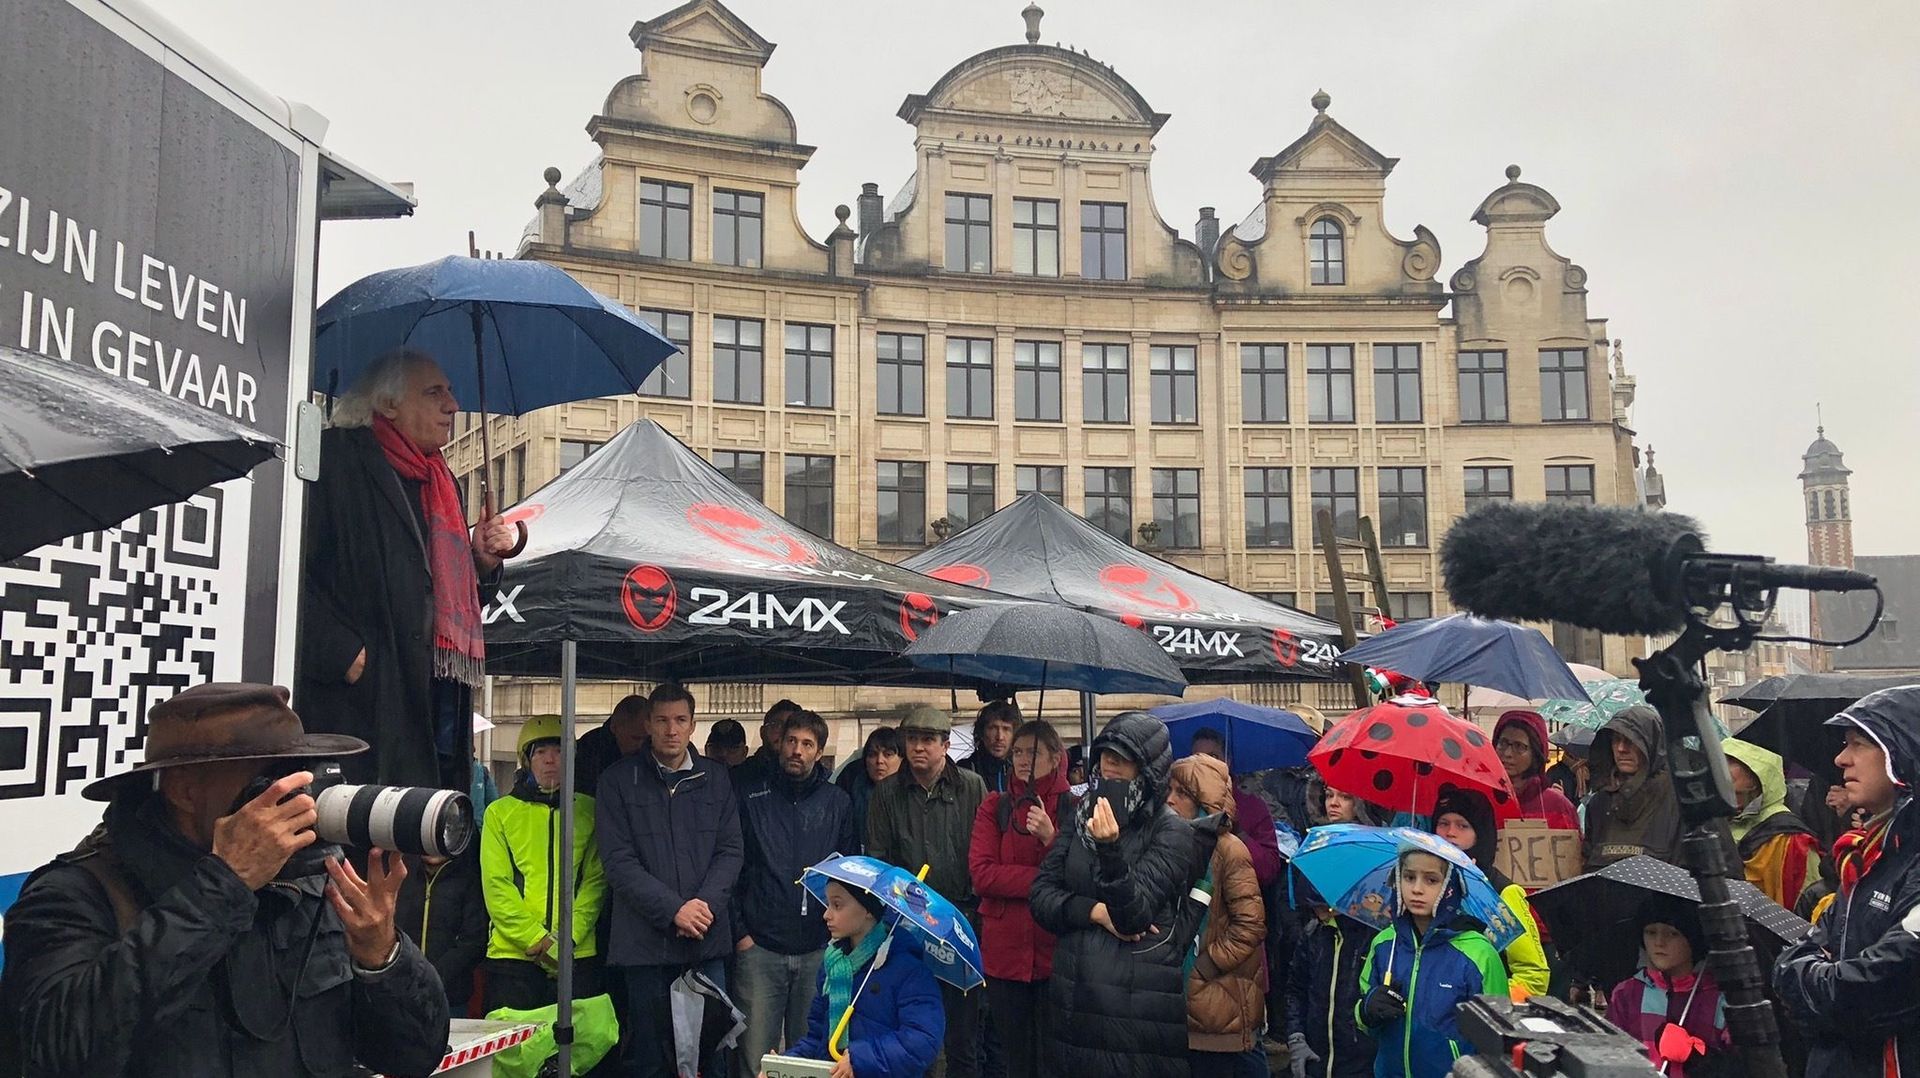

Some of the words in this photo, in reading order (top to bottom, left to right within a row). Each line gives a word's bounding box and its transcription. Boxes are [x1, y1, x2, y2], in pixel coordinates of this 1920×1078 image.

[114, 240, 247, 345] LEVEN
[20, 290, 75, 362] IN
[91, 320, 257, 423] GEVAAR
[688, 586, 852, 635] 24MX
[1153, 625, 1245, 658] 24MX
